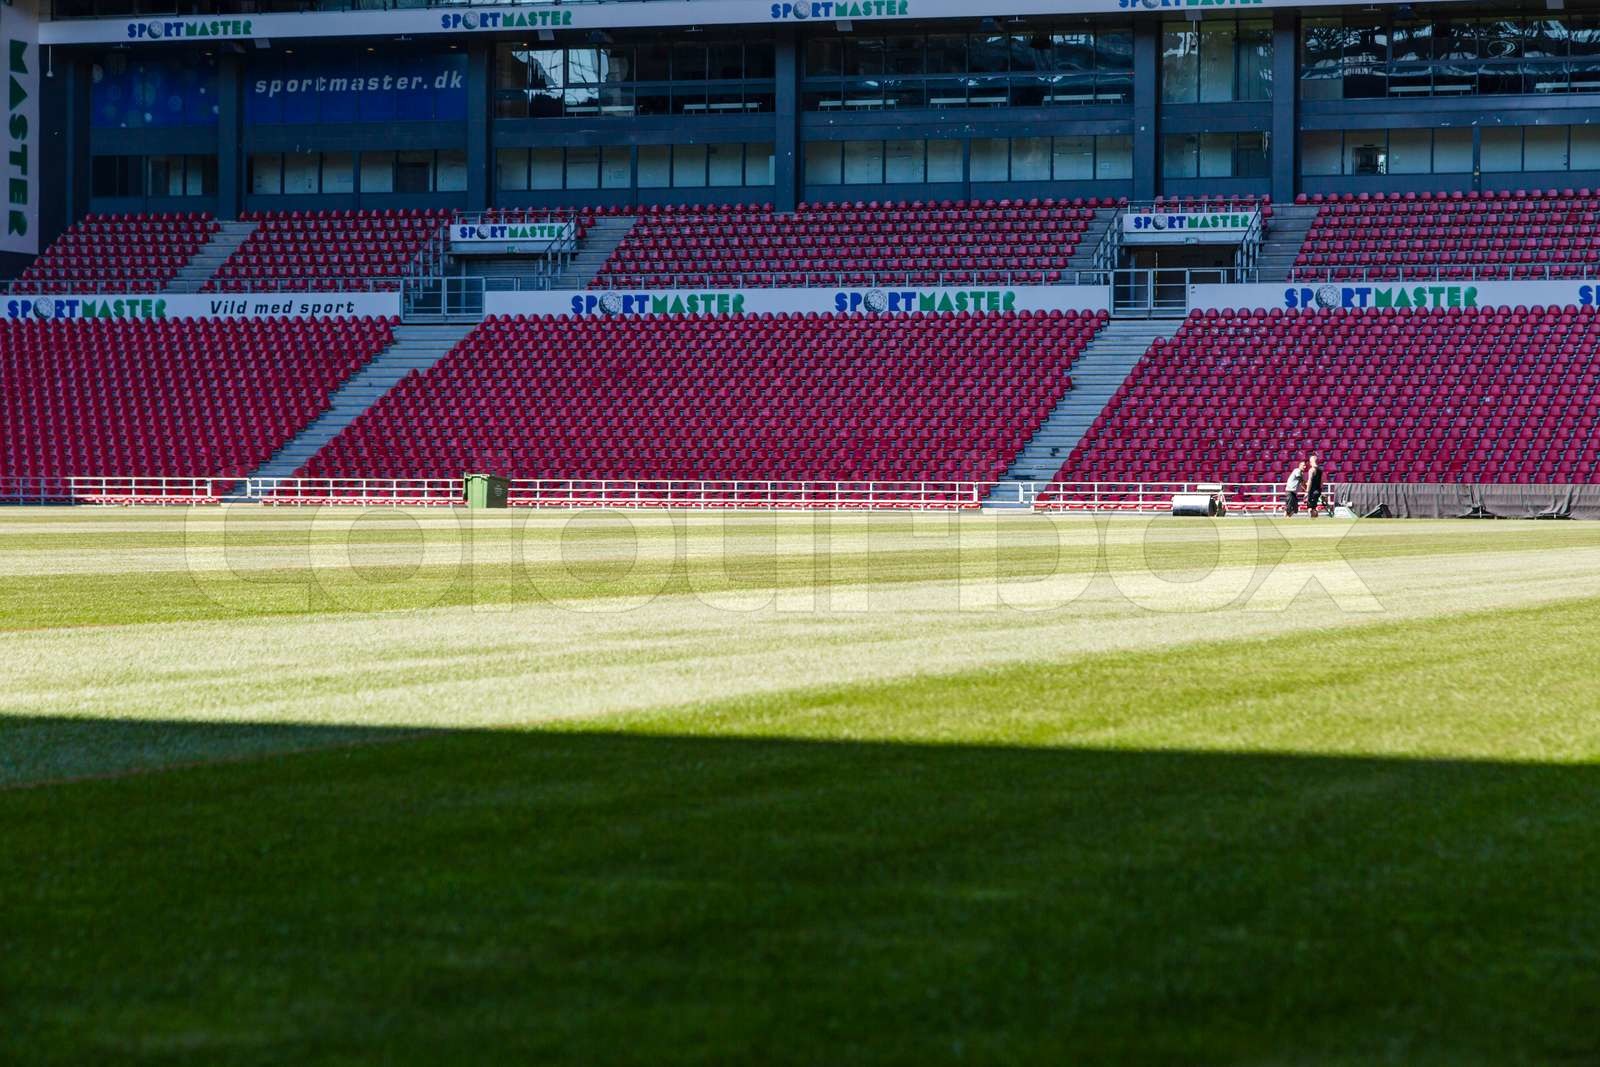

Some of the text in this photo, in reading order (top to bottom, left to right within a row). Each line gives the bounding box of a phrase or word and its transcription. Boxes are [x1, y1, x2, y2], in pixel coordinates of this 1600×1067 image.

[441, 10, 572, 30] SPORTMASTER
[771, 0, 909, 19] SPORTMASTER
[127, 20, 252, 39] SPORTMASTER
[255, 70, 463, 97] sportmaster.dk
[1134, 214, 1250, 230] SPORTMASTER
[7, 296, 167, 319] SPORTMASTER
[571, 291, 745, 315] SPORTMASTER
[834, 288, 1016, 313] SPORTMASTER
[1284, 284, 1478, 310] SPORTMASTER
[210, 300, 355, 316] Vild med sport
